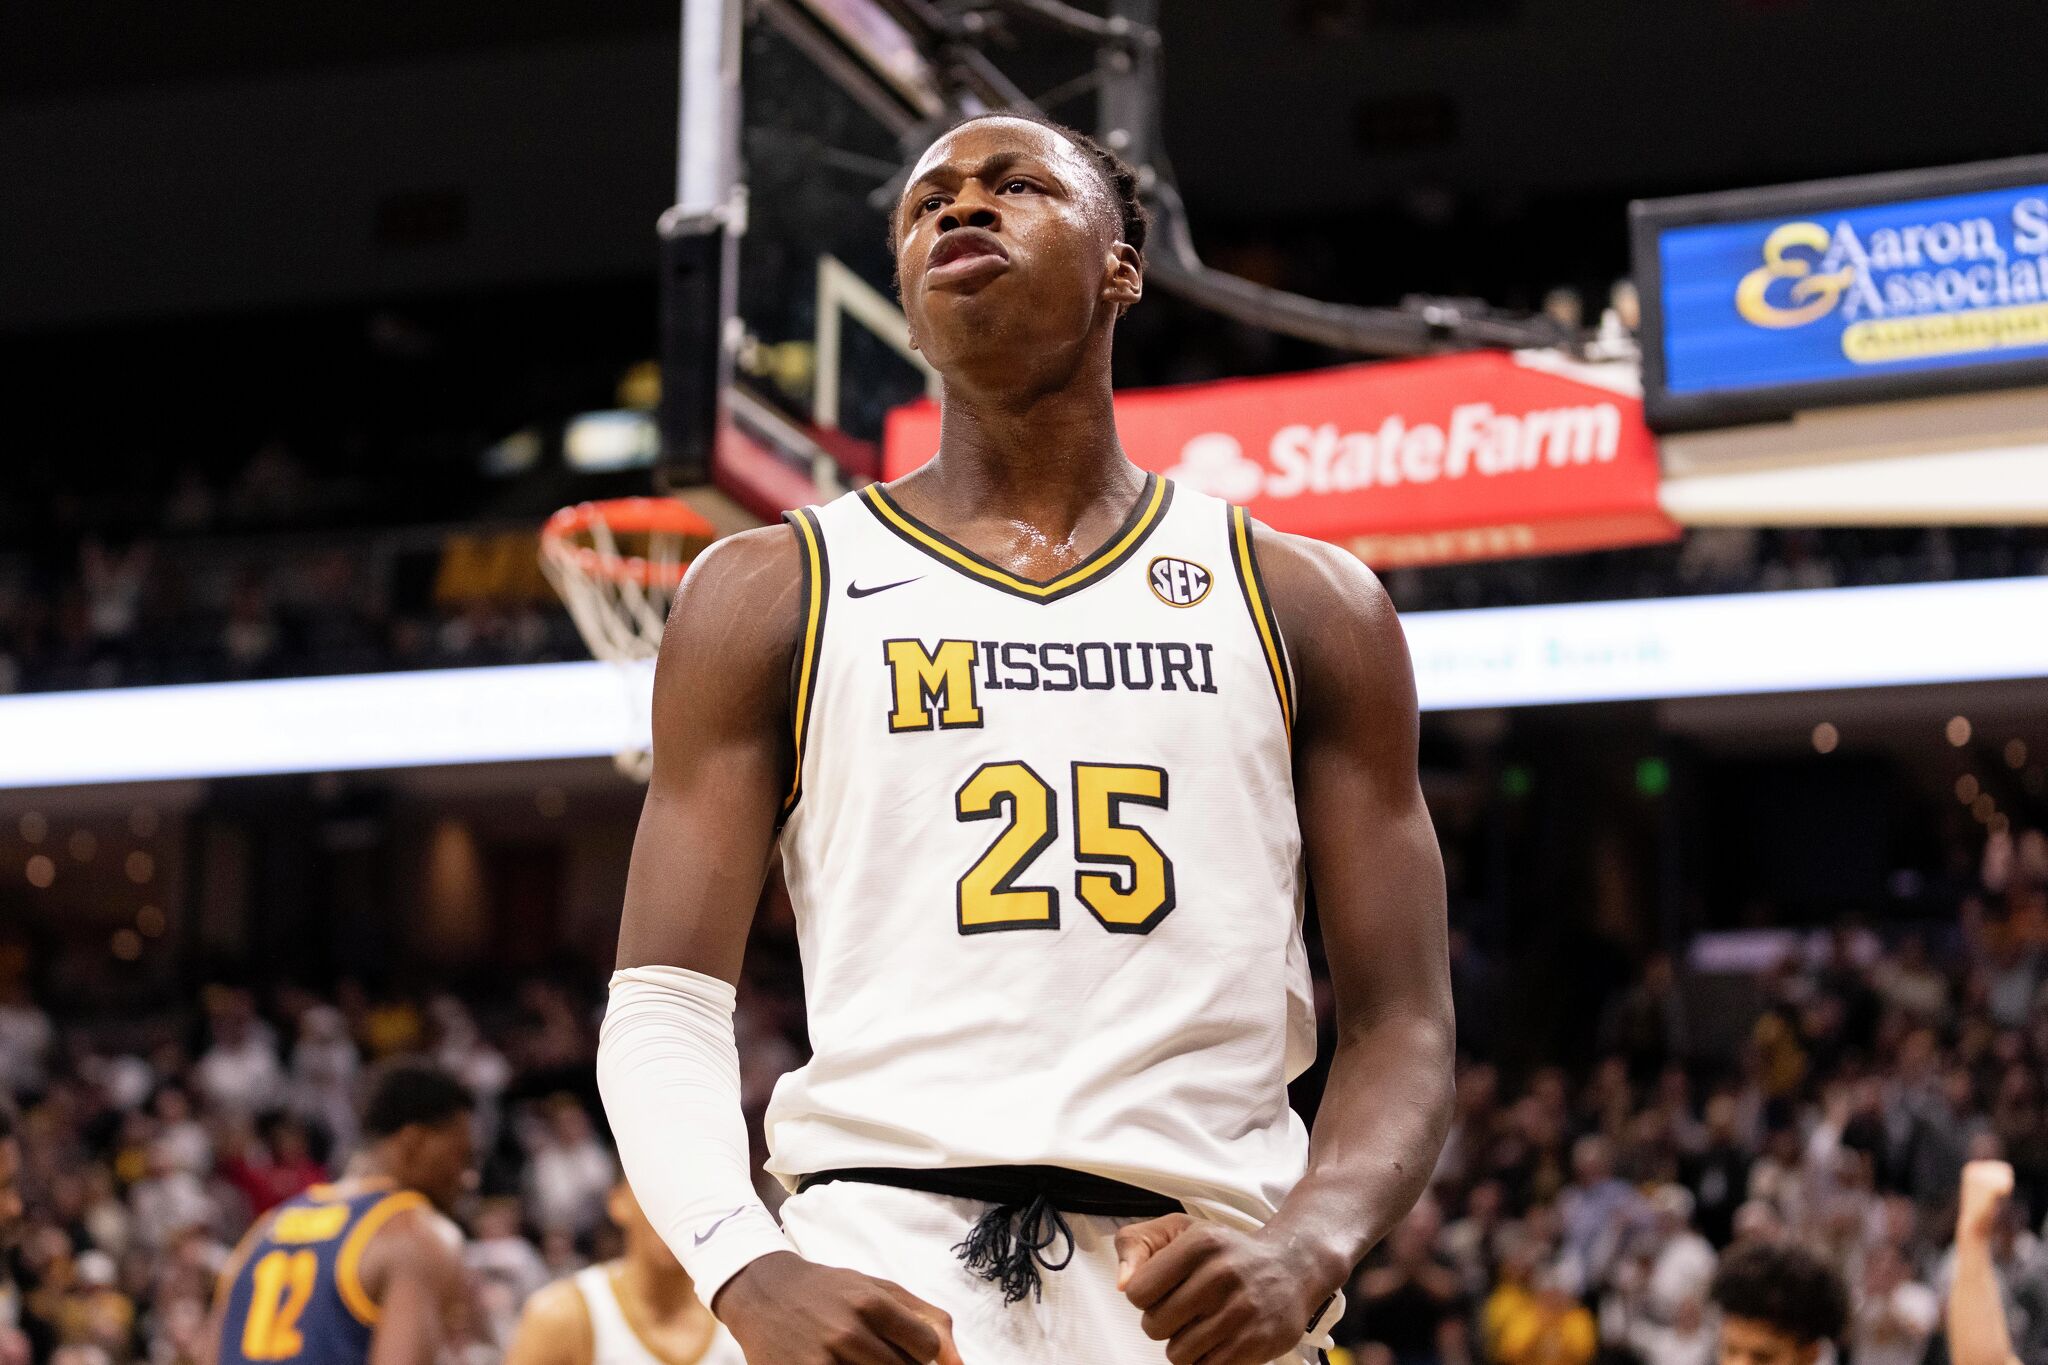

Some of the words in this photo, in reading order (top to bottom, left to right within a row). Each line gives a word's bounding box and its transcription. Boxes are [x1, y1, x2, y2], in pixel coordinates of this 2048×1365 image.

[1822, 217, 1998, 273] Aaron
[1150, 557, 1210, 604] SEC
[882, 638, 1218, 734] MISSOURI
[954, 759, 1177, 936] 25
